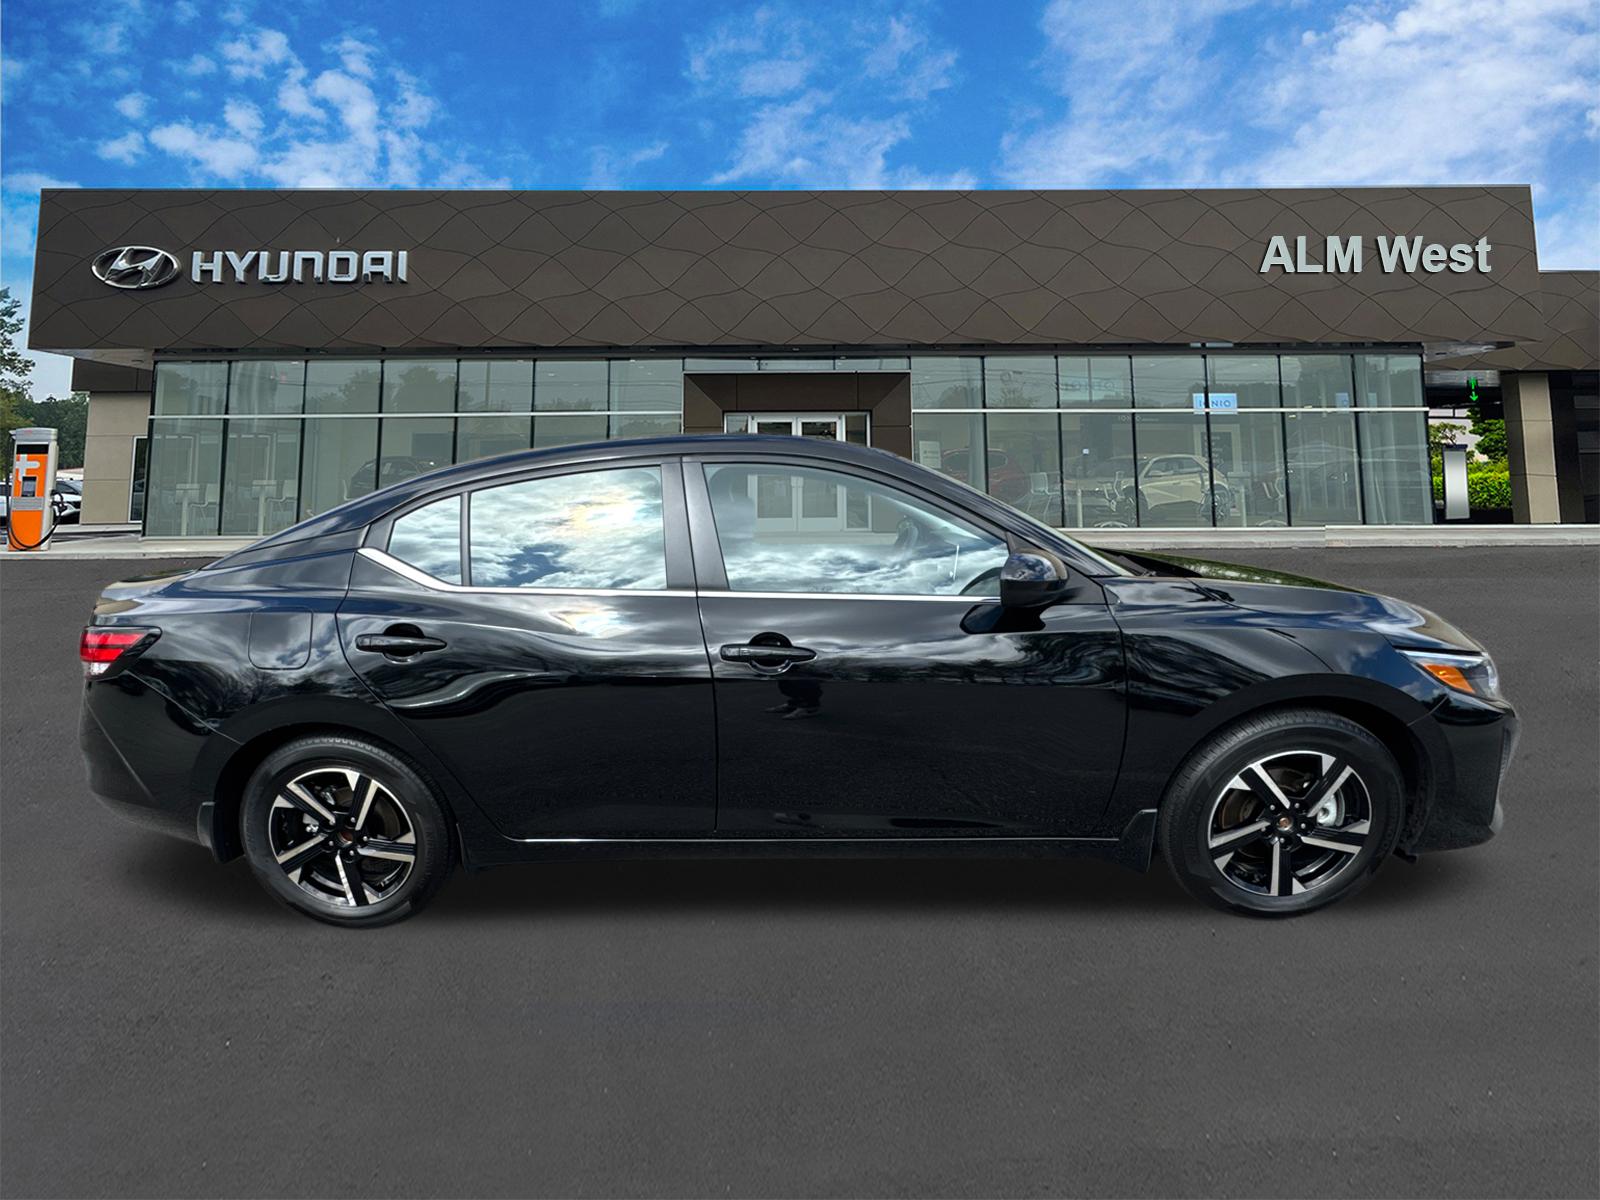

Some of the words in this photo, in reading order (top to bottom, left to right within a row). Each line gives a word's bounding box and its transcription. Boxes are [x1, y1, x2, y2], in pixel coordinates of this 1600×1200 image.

[192, 250, 408, 283] HYUNDAI
[1259, 235, 1363, 273] ALM
[1377, 235, 1492, 273] West
